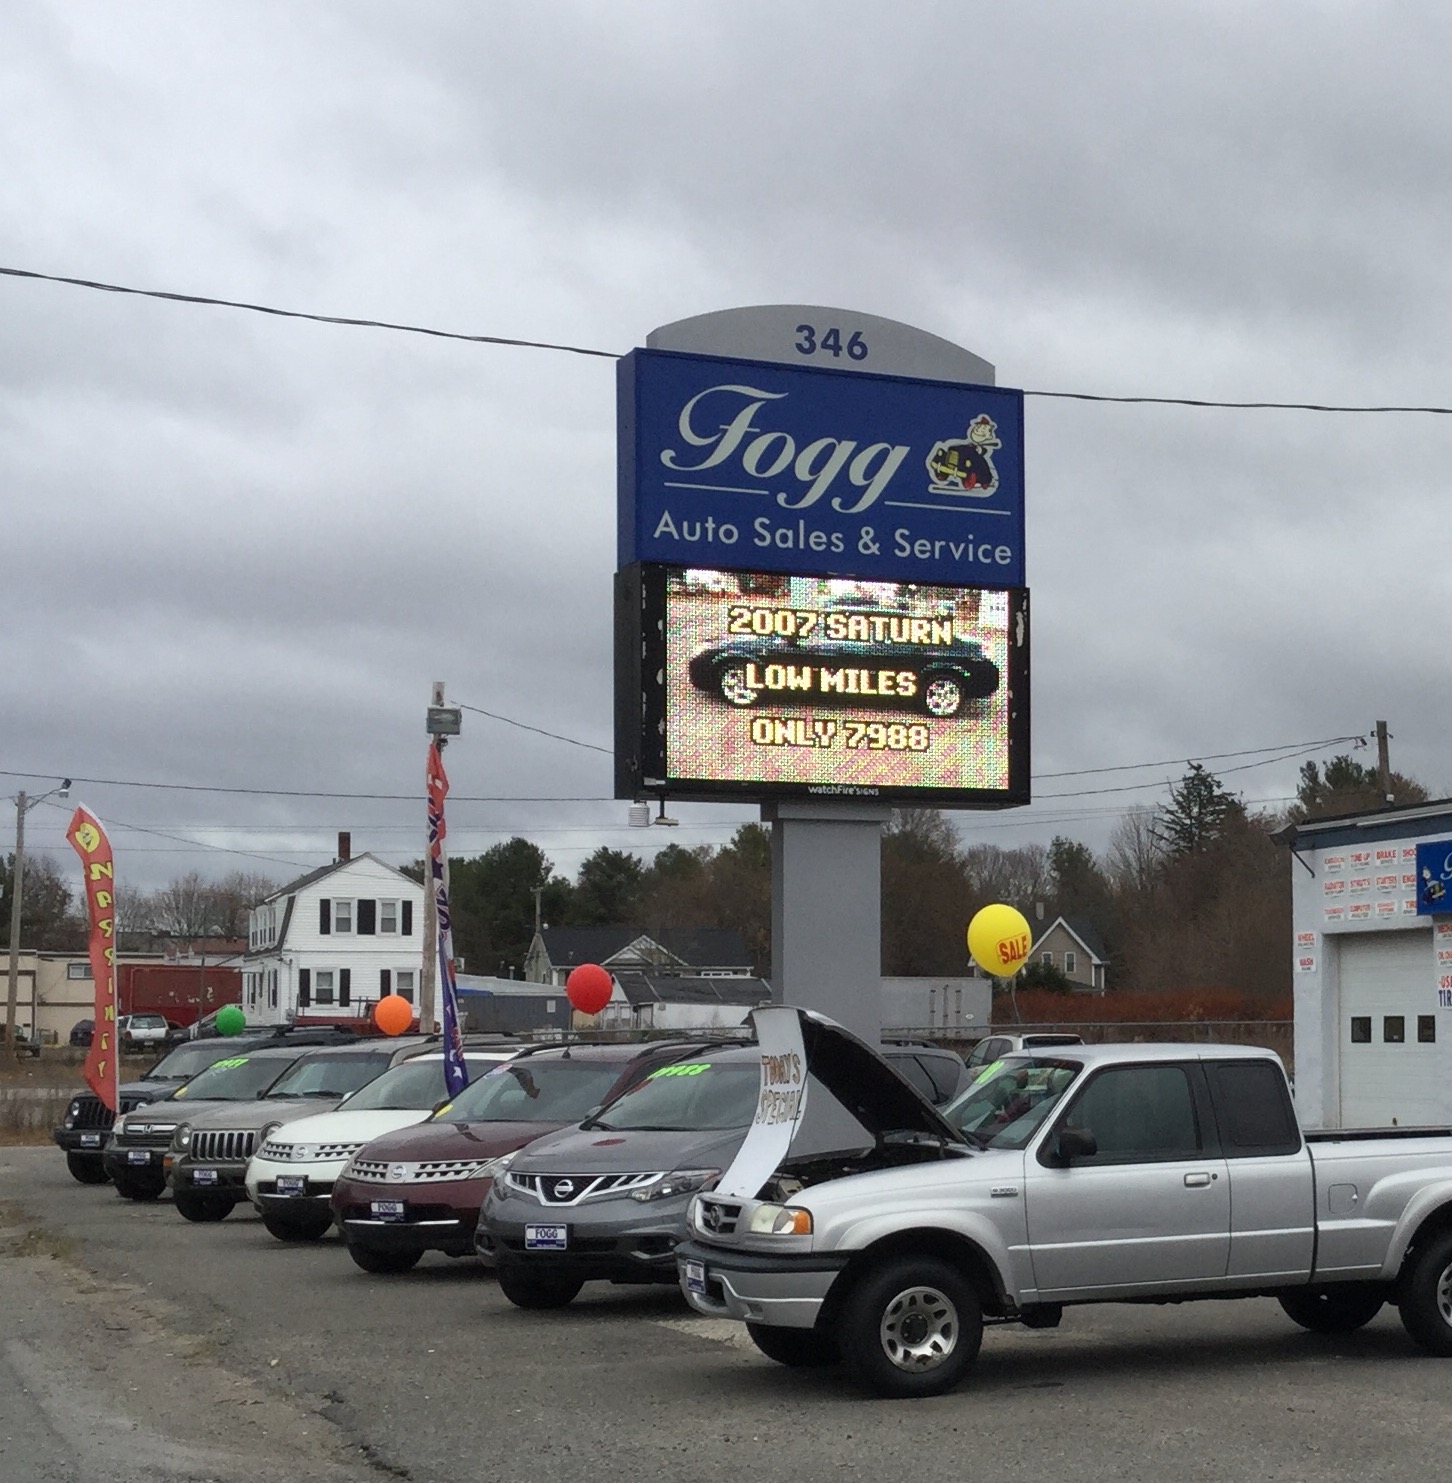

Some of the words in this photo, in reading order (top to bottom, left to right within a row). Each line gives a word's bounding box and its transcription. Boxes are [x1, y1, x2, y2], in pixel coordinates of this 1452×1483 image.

[795, 324, 869, 361] 346
[660, 384, 911, 514] Fogg
[653, 510, 739, 544] Auto
[753, 517, 845, 553] Sales
[858, 526, 881, 555] &
[894, 529, 1012, 564] Service
[730, 607, 817, 637] 2007
[826, 613, 952, 645] SATURN
[746, 663, 812, 690] LOW
[820, 668, 918, 696] MILES
[752, 718, 836, 748] ONLY
[845, 723, 929, 750] 7988
[1376, 850, 1396, 859] BRAKE
[998, 935, 1028, 964] SALE
[535, 1228, 559, 1239] FOGG
